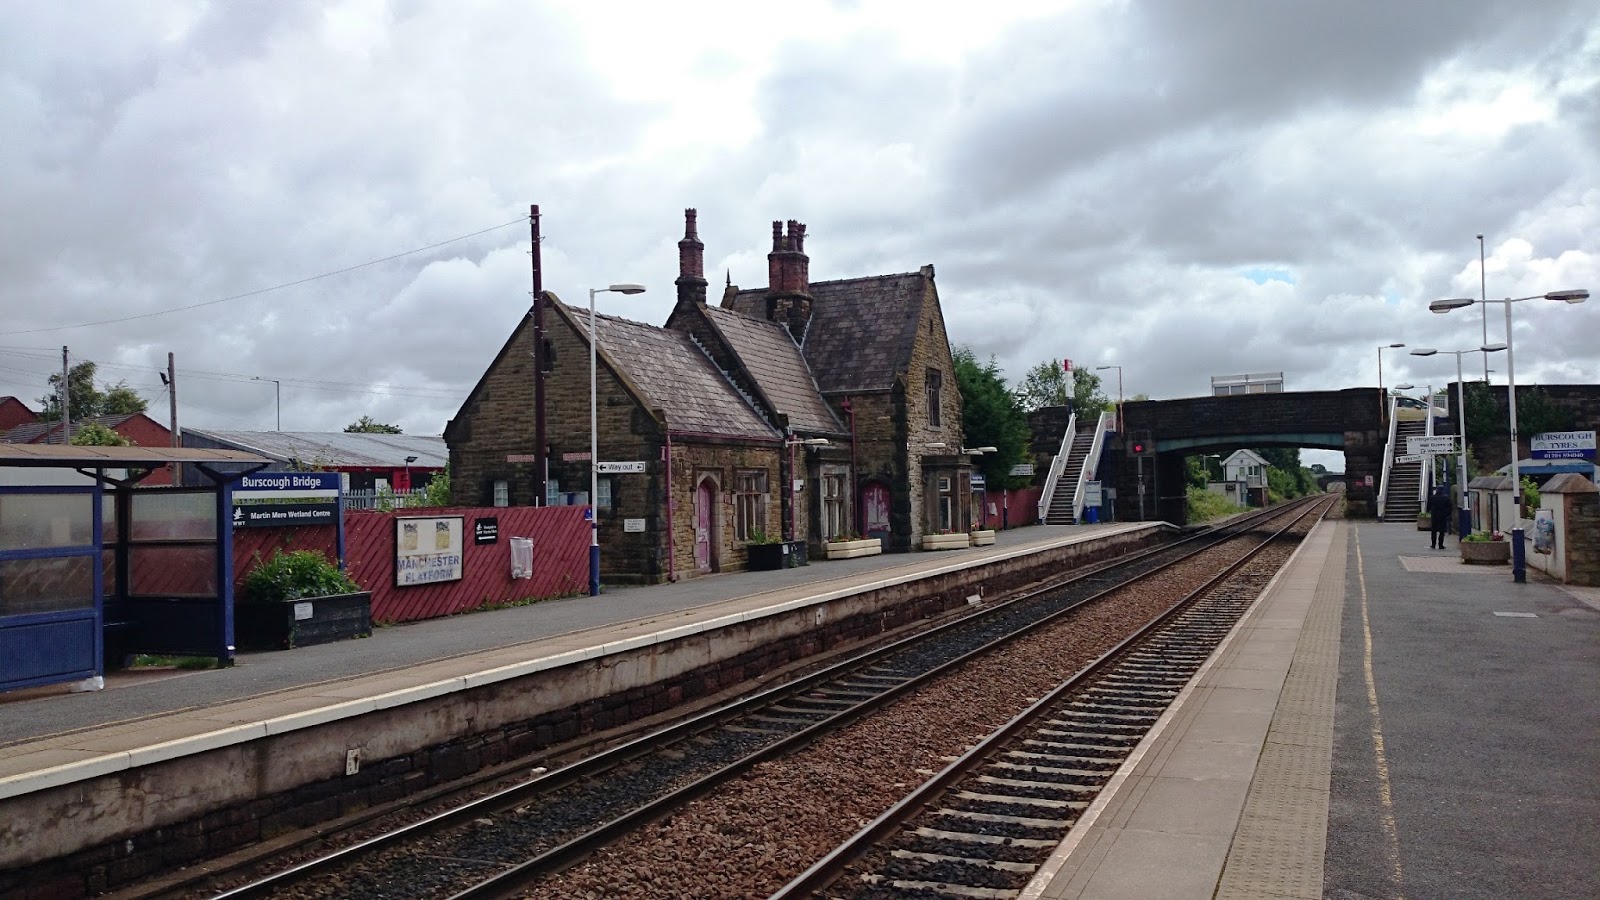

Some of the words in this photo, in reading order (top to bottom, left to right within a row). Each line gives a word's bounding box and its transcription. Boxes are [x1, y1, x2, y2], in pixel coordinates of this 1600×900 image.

[1535, 433, 1592, 441] BURSCOUGH
[242, 476, 290, 489] Burscough
[292, 476, 321, 489] Bridge
[250, 512, 271, 520] Martin
[271, 511, 287, 519] Mere
[287, 510, 312, 518] Wetland
[312, 509, 331, 517] Centre
